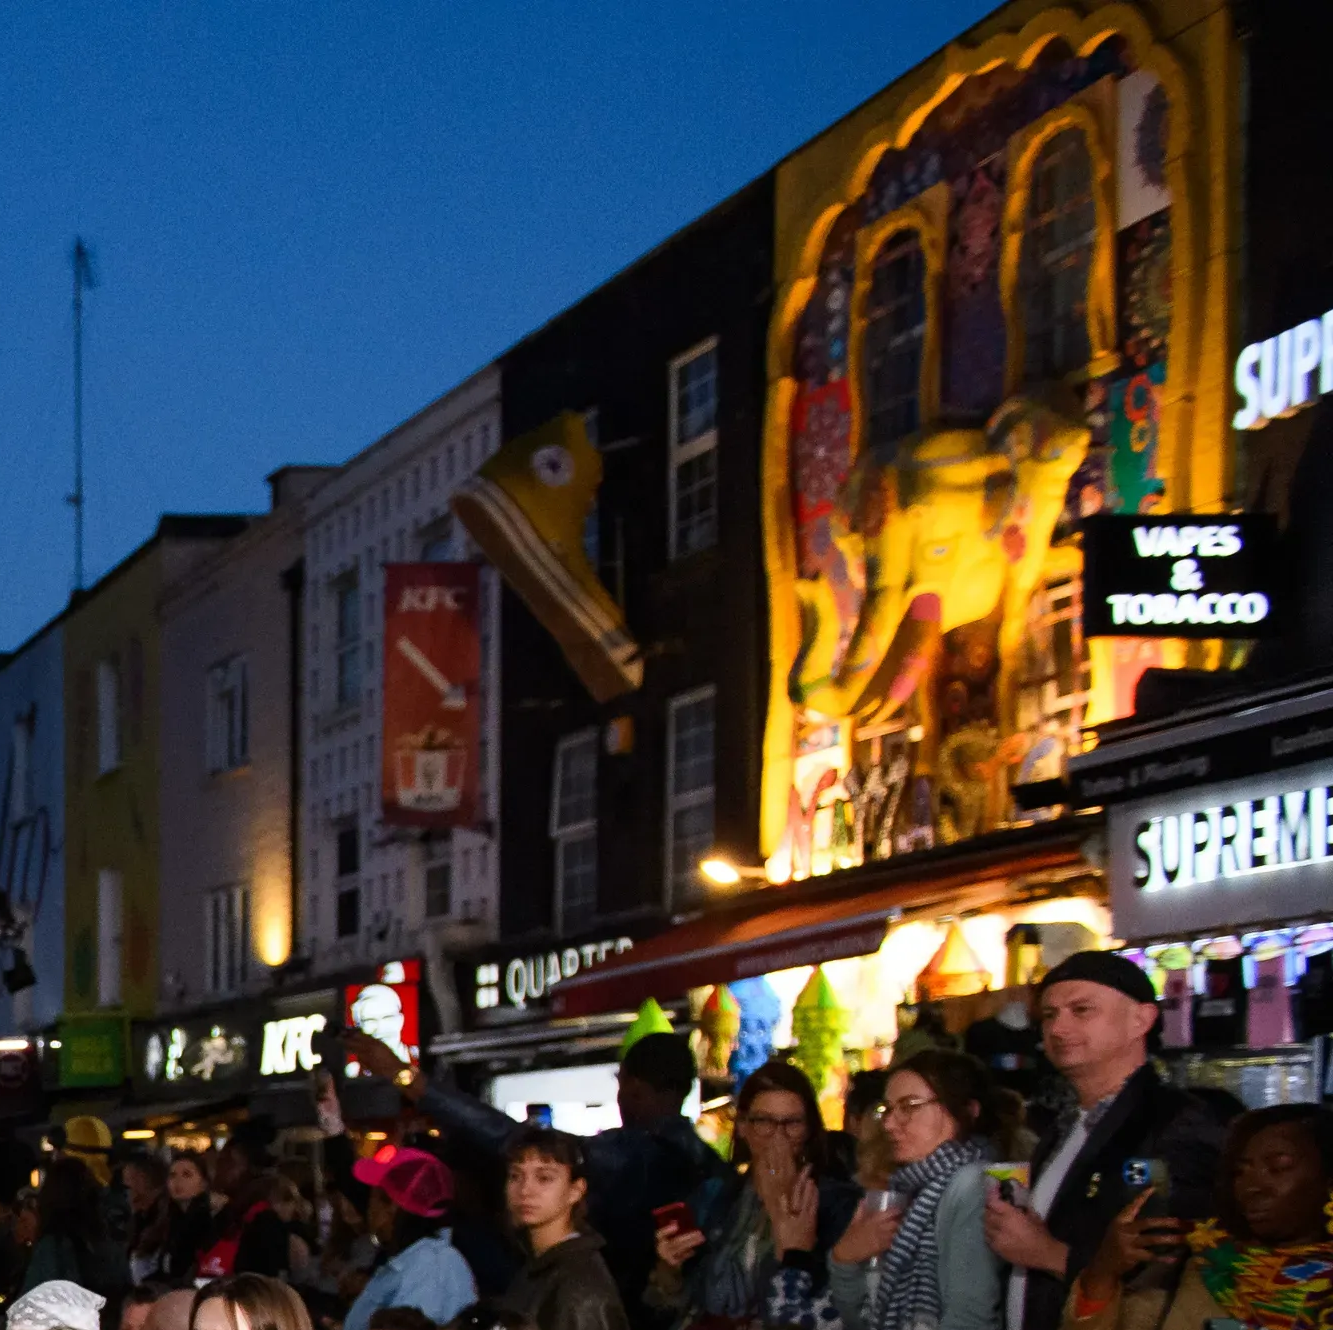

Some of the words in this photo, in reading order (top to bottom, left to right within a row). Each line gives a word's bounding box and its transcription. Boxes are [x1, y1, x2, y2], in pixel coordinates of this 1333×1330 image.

[1231, 308, 1333, 430] SUP
[1132, 524, 1244, 557] VAPES
[1169, 557, 1205, 592] &
[395, 586, 468, 614] KFC
[1106, 591, 1271, 625] TOBACCO
[1132, 785, 1333, 892] SUPREM
[259, 1013, 327, 1076] KFC
